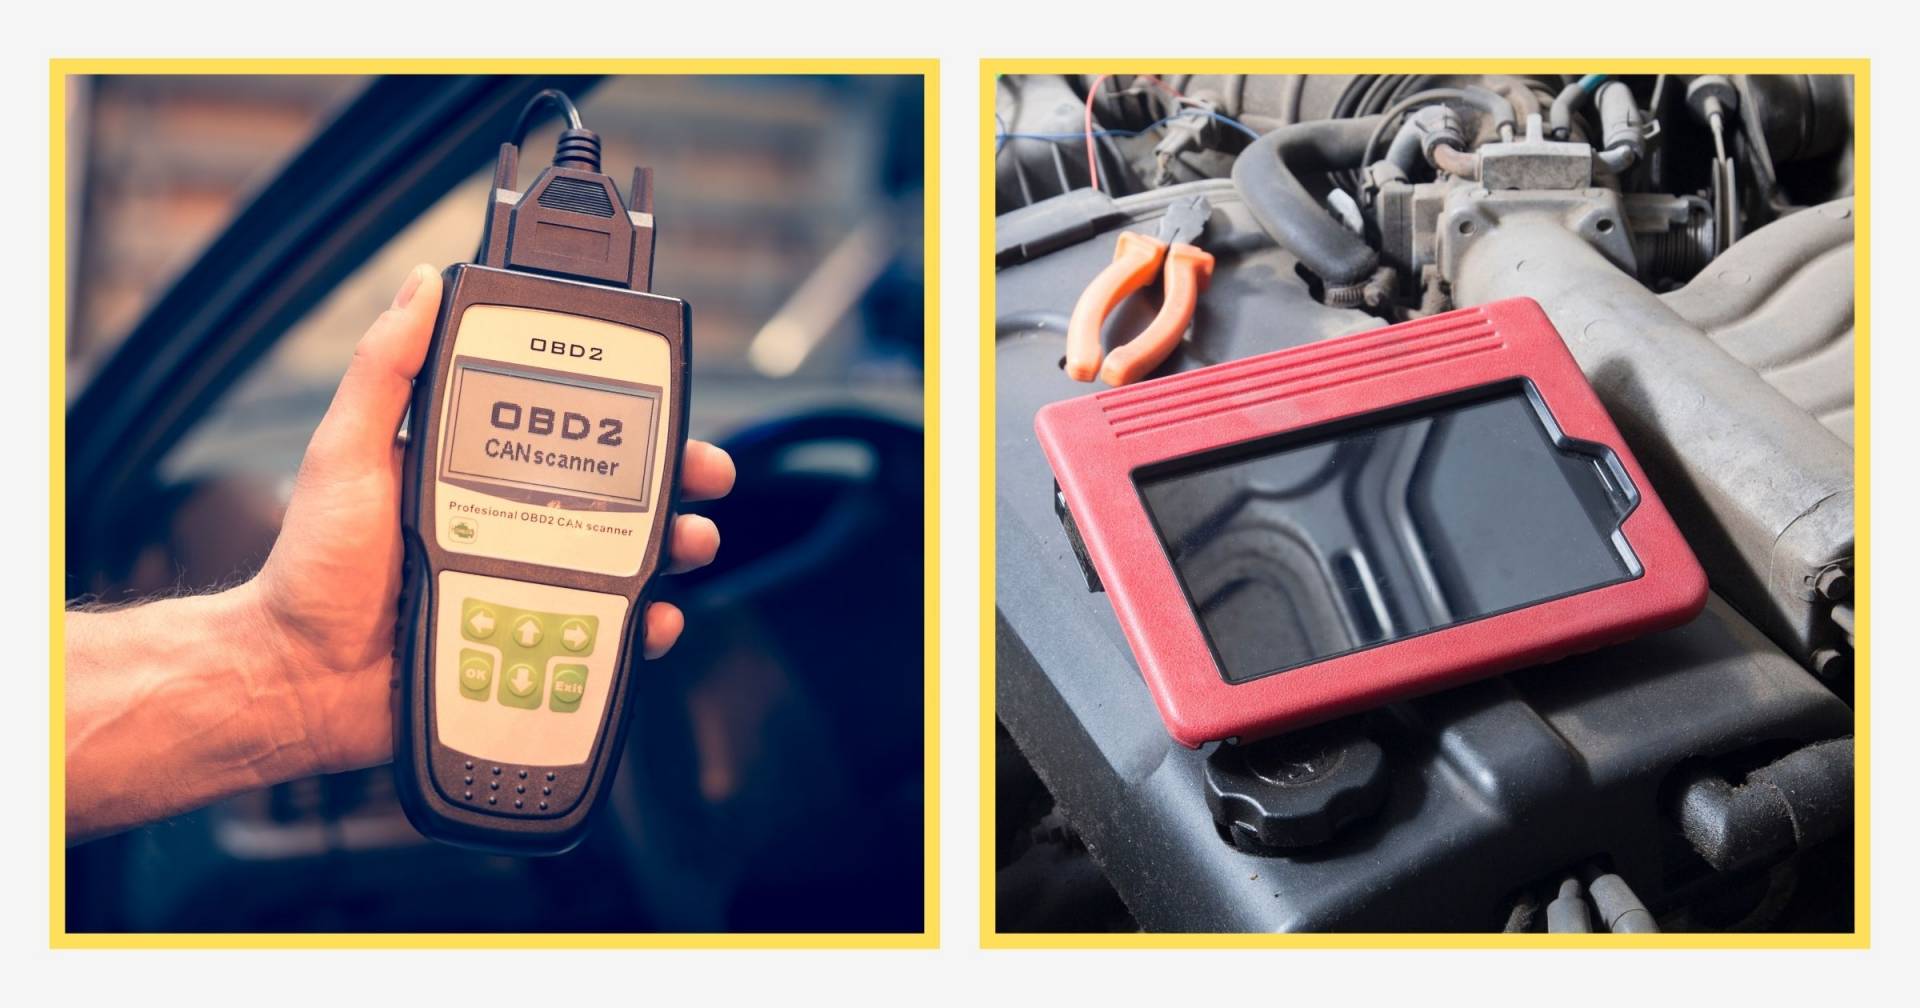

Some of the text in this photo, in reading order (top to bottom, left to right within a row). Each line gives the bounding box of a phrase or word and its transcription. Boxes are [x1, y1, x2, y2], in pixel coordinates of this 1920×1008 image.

[530, 338, 603, 361] OBD2
[490, 401, 623, 447] OBD2
[449, 501, 633, 537] Profesional OBD2 CAN scanner
[465, 669, 487, 681] OK
[554, 682, 583, 695] Exit
